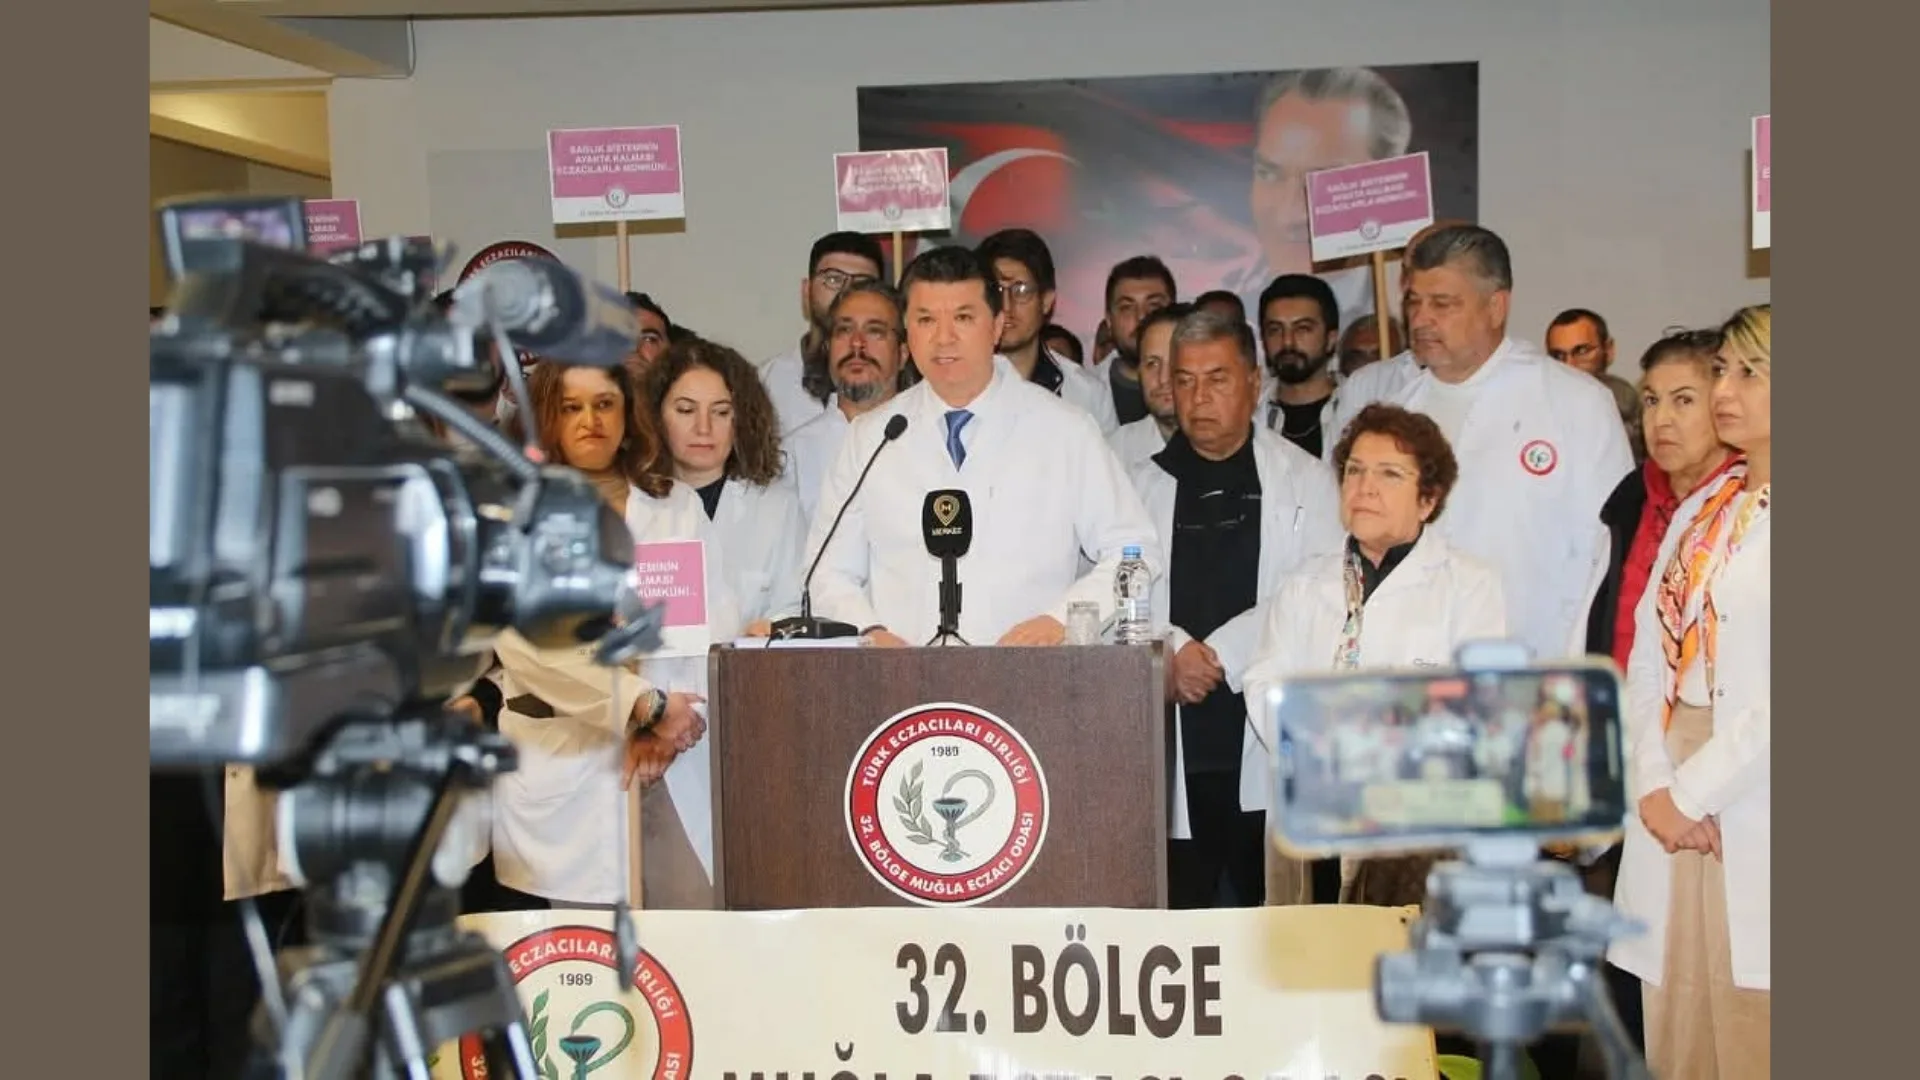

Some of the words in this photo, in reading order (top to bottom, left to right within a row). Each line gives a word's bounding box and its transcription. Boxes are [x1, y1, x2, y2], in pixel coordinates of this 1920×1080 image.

[862, 744, 890, 787] TÜRK
[888, 718, 982, 749] ECZACILARI
[983, 731, 1031, 785] BİRLİĞİ
[930, 746, 959, 757] 1989
[860, 814, 875, 839] 32.
[869, 840, 909, 881] BÖLGE
[909, 876, 965, 895] MUĞLA
[966, 859, 1013, 891] ECZACI
[1010, 812, 1034, 857] ODASI
[509, 938, 617, 975] ECZACILAR
[632, 965, 675, 1019] İRLİĞİ
[559, 973, 593, 986] 1989
[895, 941, 988, 1035] 32.
[1011, 923, 1223, 1038] BÖLGE
[662, 1052, 682, 1080] ASI
